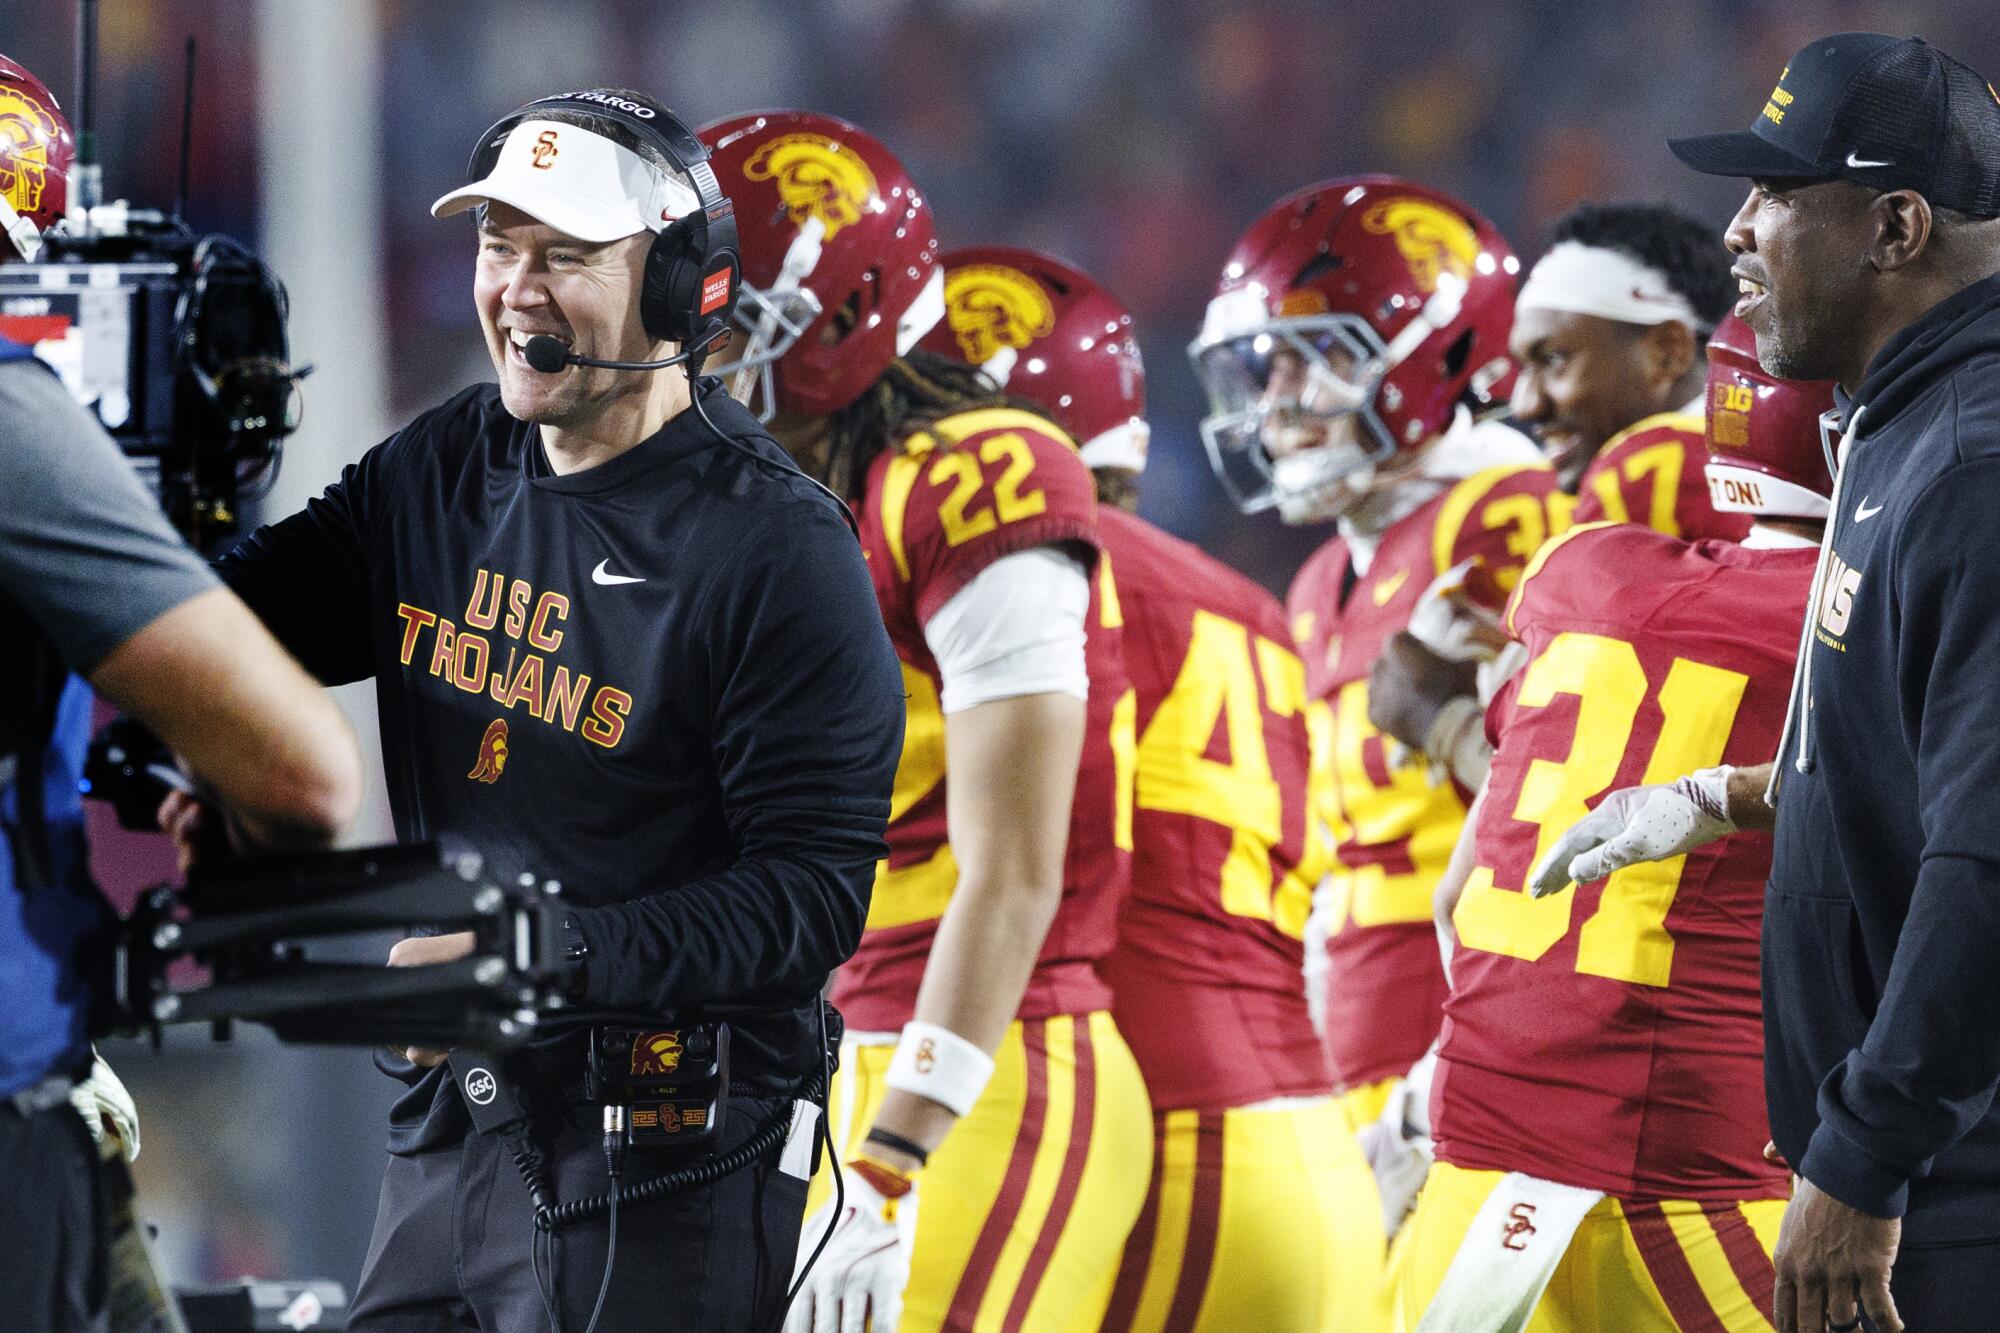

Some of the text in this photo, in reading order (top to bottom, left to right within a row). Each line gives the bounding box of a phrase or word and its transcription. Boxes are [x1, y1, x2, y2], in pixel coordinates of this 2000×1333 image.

[577, 91, 655, 119] FARGO
[704, 287, 727, 304] FARGO
[705, 278, 728, 294] WELLS
[928, 432, 1047, 549] 22
[1594, 440, 1685, 536] 17
[1725, 480, 1763, 506] ON!
[465, 568, 570, 653] USC
[397, 602, 633, 748] TROJANS
[1452, 632, 1749, 988] 31
[469, 1075, 493, 1096] GSC
[1503, 1203, 1536, 1251] SC
